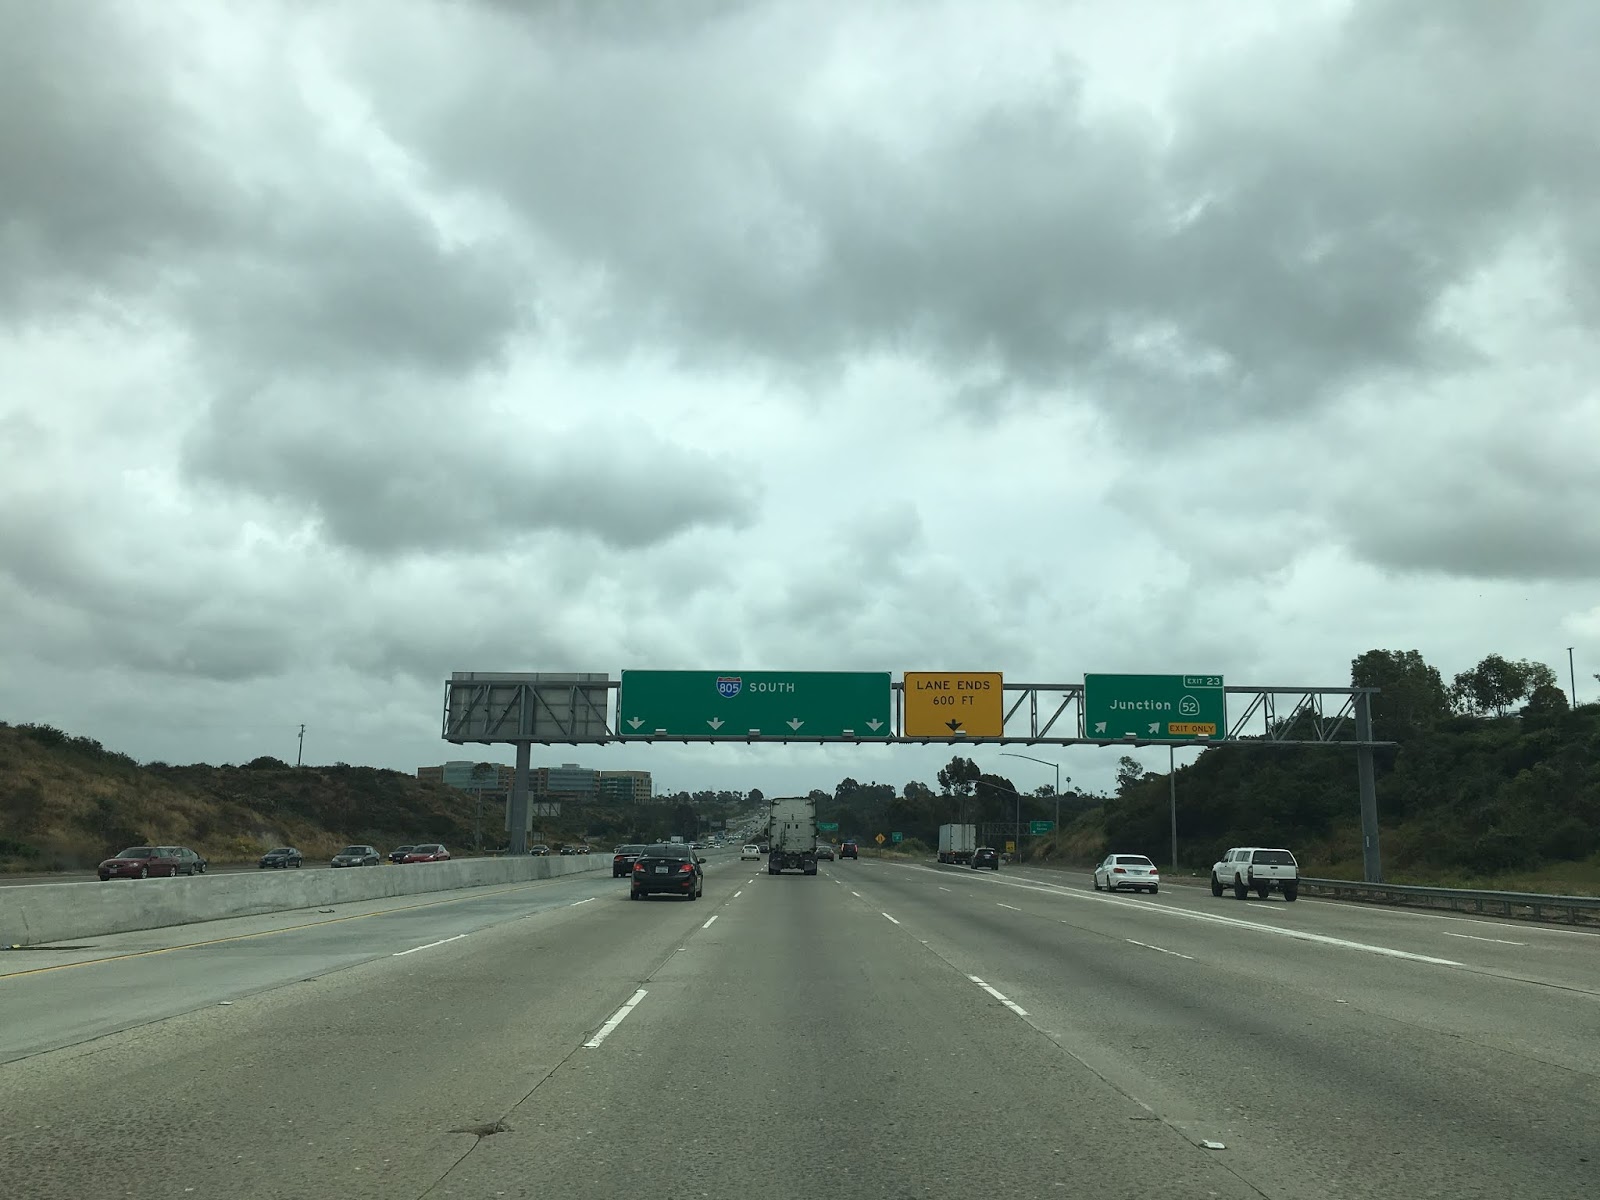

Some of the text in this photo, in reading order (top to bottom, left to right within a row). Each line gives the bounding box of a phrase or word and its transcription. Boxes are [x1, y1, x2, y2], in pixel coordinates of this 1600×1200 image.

[916, 680, 991, 690] LANE ENDS
[1206, 677, 1221, 686] 23
[719, 682, 795, 694] 805 SOUTH
[932, 695, 975, 706] 600 FT
[1109, 699, 1197, 712] Junction 52
[1191, 725, 1214, 733] ONLY
